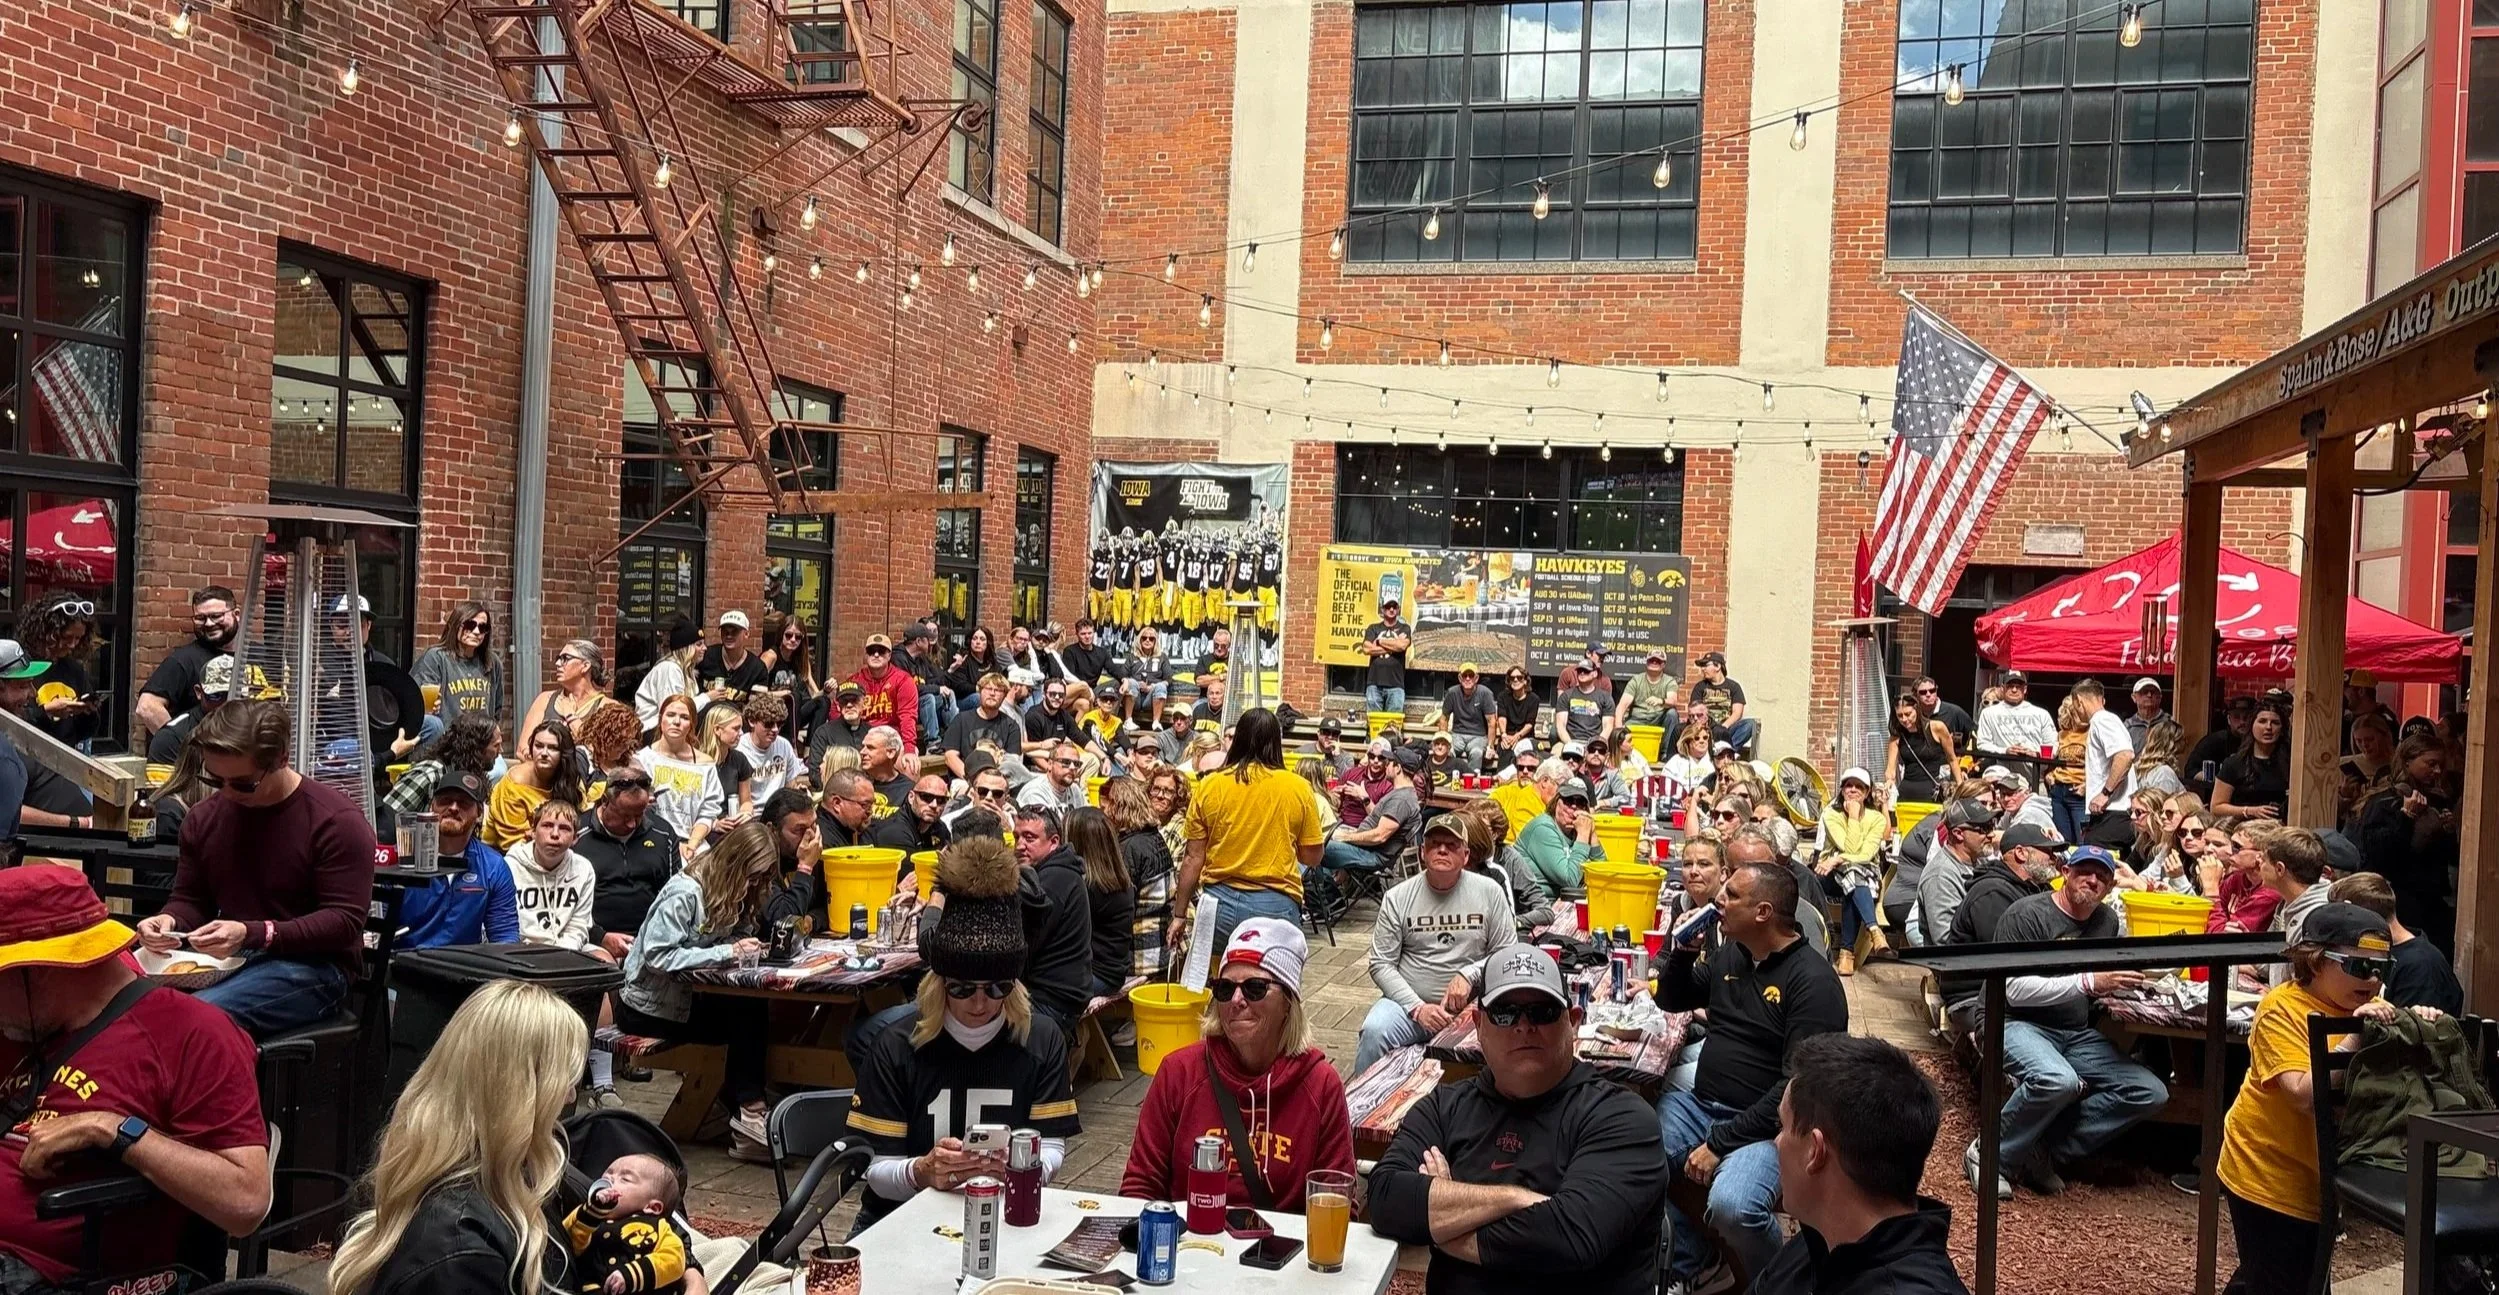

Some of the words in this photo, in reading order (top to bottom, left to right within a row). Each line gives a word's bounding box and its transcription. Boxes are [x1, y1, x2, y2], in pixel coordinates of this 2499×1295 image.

[2279, 291, 2433, 400] Spahn&Rose/A&G
[1120, 480, 1150, 496] IOWA
[1181, 480, 1215, 493] FIGHT
[1195, 494, 1228, 509] IOWA
[1166, 551, 1175, 568] 4
[1264, 554, 1278, 571] 57
[1383, 556, 1402, 564] IOWA
[1403, 557, 1443, 565] HAWKEYES
[1535, 557, 1626, 574] HAWKEYES
[1095, 563, 1110, 579] 22
[1120, 562, 1130, 579] 7
[1140, 559, 1155, 577] 39
[1187, 562, 1200, 579] 18
[1209, 563, 1224, 582] 17
[1239, 562, 1253, 580] 95
[1334, 568, 1351, 579] THE
[1333, 580, 1374, 592] OFFICIAL
[1333, 591, 1364, 602] CRAFT
[1534, 590, 1546, 599] AUG
[1548, 591, 1557, 599] 30
[1604, 592, 1616, 600] OCT
[1639, 593, 1654, 602] Penn
[1655, 594, 1673, 603] State
[1332, 603, 1355, 613] BEER
[1533, 602, 1546, 610] SEP
[1566, 603, 1581, 612] Iowa
[1582, 604, 1599, 612] State
[1604, 605, 1616, 613] OCT
[1629, 606, 1637, 614] vs
[1638, 605, 1671, 615] Minnesota
[1331, 613, 1341, 624] OF
[1346, 614, 1364, 625] THE
[1532, 614, 1545, 623] SEP
[1546, 615, 1553, 623] 13
[1603, 617, 1617, 625] NOV
[1637, 618, 1660, 628] Oregon
[1331, 627, 1365, 638] HAWK
[1532, 626, 1544, 635] SEP
[1564, 628, 1589, 638] Rutgers
[1602, 630, 1616, 638] NOV
[1617, 630, 1625, 638] 15
[1636, 631, 1650, 639] USC
[1531, 638, 1544, 647] SEP
[1544, 639, 1553, 648] 27
[1617, 643, 1626, 651] 22
[1666, 644, 1684, 653] State
[1530, 651, 1543, 659] OCT
[1544, 651, 1549, 660] 11
[1563, 652, 1584, 661] Wisco
[839, 681, 858, 692] IOWA
[460, 697, 486, 710] STATE
[516, 886, 579, 910] IOWA
[1407, 913, 1484, 928] IOWA
[52, 1064, 100, 1102] NES
[1197, 1197, 1212, 1205] TWO
